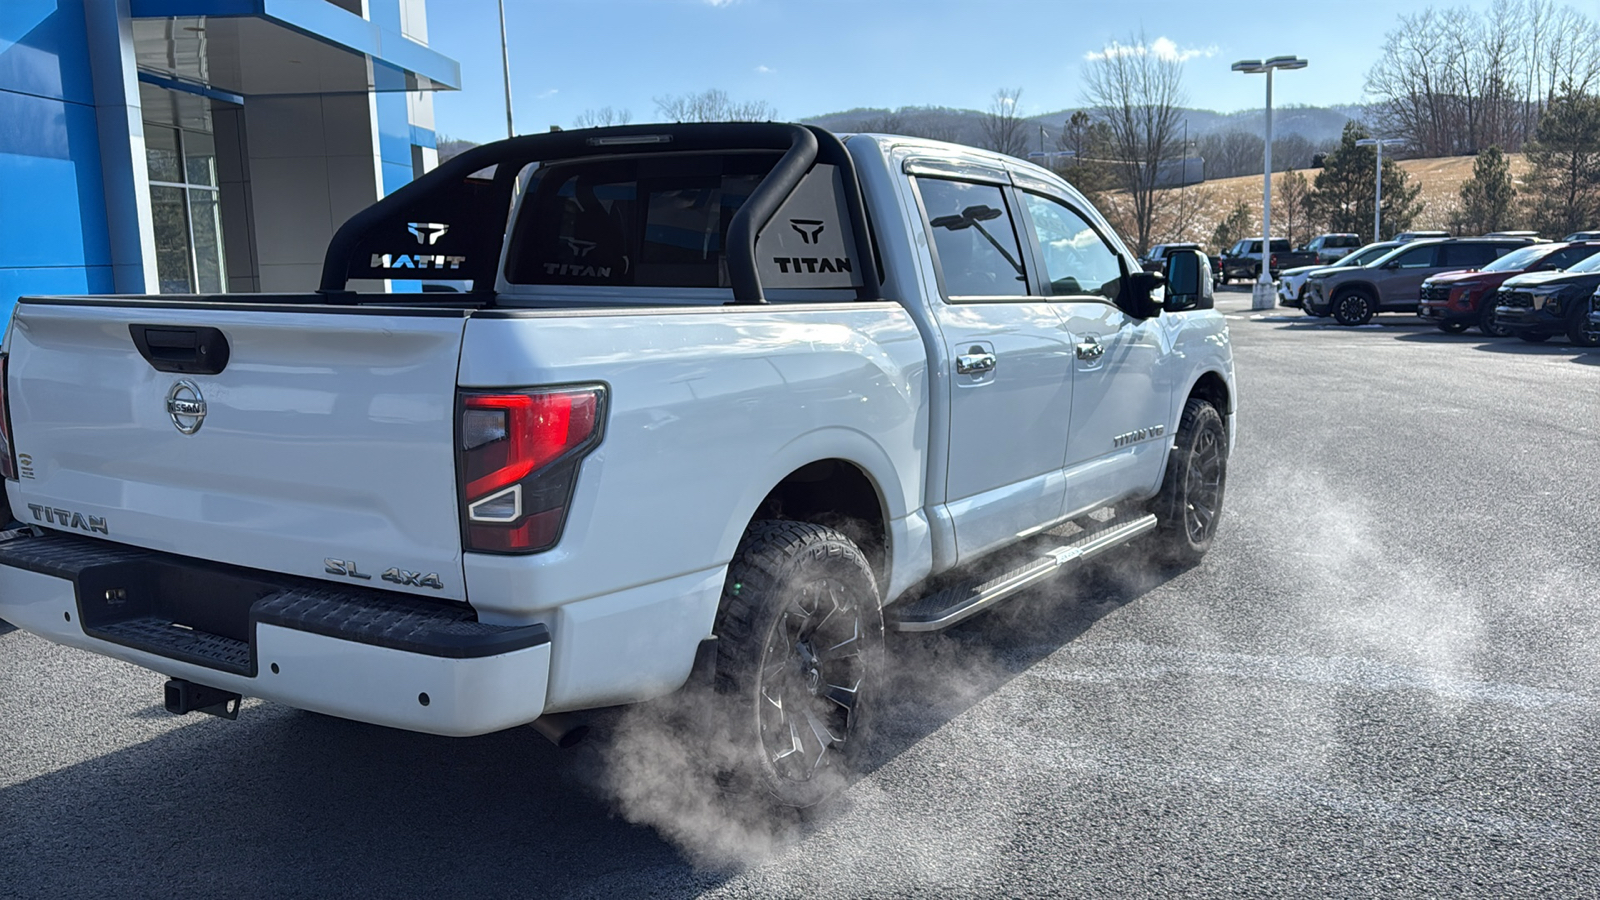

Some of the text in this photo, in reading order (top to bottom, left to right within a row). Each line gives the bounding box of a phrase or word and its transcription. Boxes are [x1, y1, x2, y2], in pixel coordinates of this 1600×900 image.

[543, 262, 611, 278] TITAN
[773, 257, 852, 273] TITAN
[168, 401, 200, 413] NISSAN
[1113, 428, 1148, 447] TITAN
[28, 503, 109, 535] TITAN
[324, 557, 372, 580] SL
